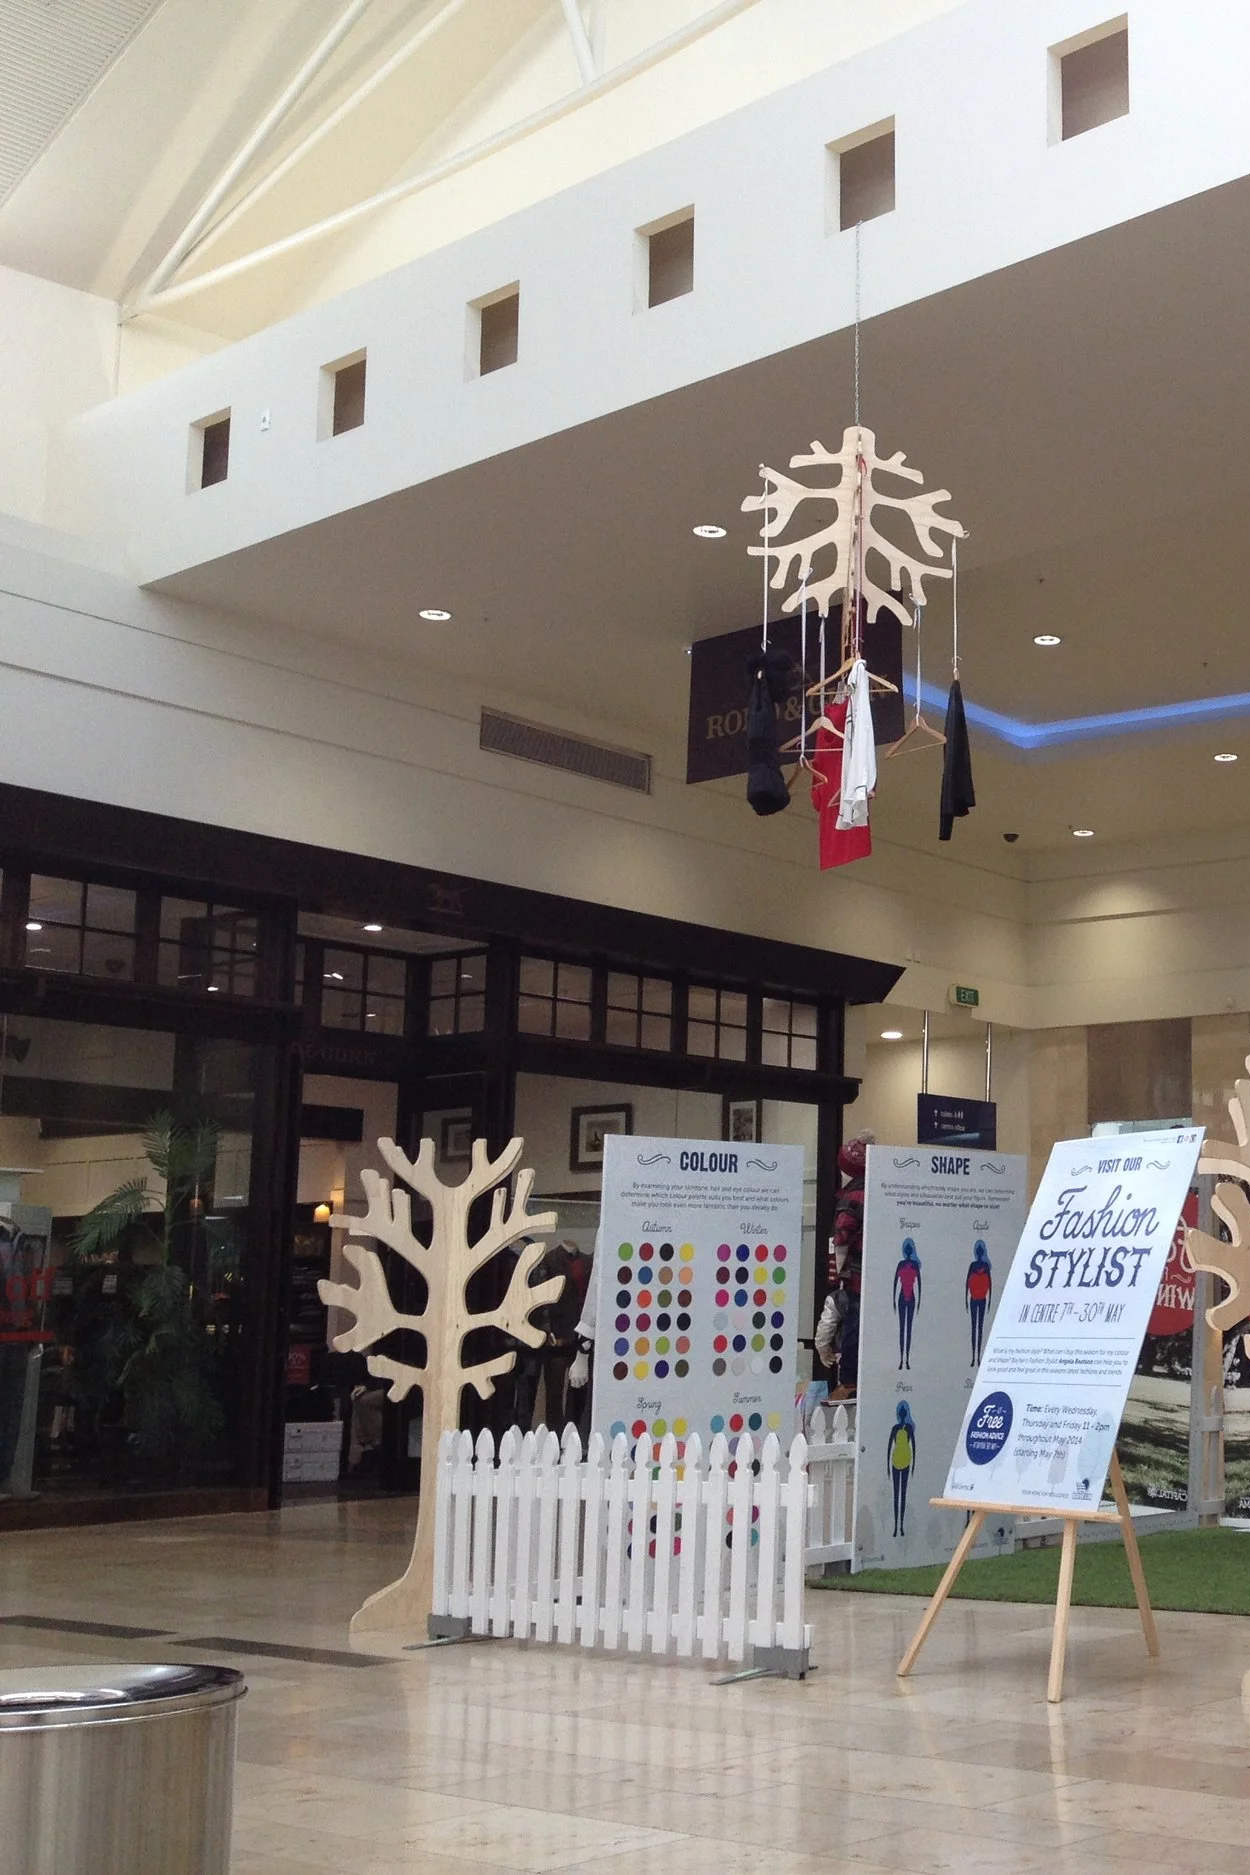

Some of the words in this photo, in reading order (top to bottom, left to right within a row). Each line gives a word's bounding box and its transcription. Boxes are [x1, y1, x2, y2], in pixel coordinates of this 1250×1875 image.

[680, 1152, 738, 1173] COLOUR
[931, 1156, 970, 1175] SHAPE
[1097, 1158, 1121, 1174] VISIT
[1123, 1157, 1142, 1171] OUR
[1040, 1185, 1160, 1240] Fashion
[740, 1223, 768, 1234] Winter
[1024, 1246, 1153, 1289] STYLIST
[1019, 1305, 1030, 1323] IN
[1030, 1304, 1058, 1323] CENTRE
[1105, 1303, 1126, 1323] MAY
[637, 1397, 661, 1415] Spring
[733, 1393, 762, 1404] Summer
[977, 1405, 1003, 1429] Free
[1027, 1404, 1042, 1412] Time:
[1044, 1405, 1060, 1414] Every
[1023, 1419, 1049, 1428] Thursday
[1050, 1419, 1061, 1427] and
[1062, 1421, 1082, 1431] Friday
[1095, 1423, 1110, 1432] 2pm
[971, 1431, 988, 1439] FASHION
[1018, 1434, 1051, 1444] throughout
[1052, 1436, 1066, 1445] May
[1067, 1436, 1082, 1444] 2014
[1013, 1449, 1038, 1458] (starting
[1039, 1450, 1052, 1459] May
[1053, 1450, 1066, 1459] 7th)
